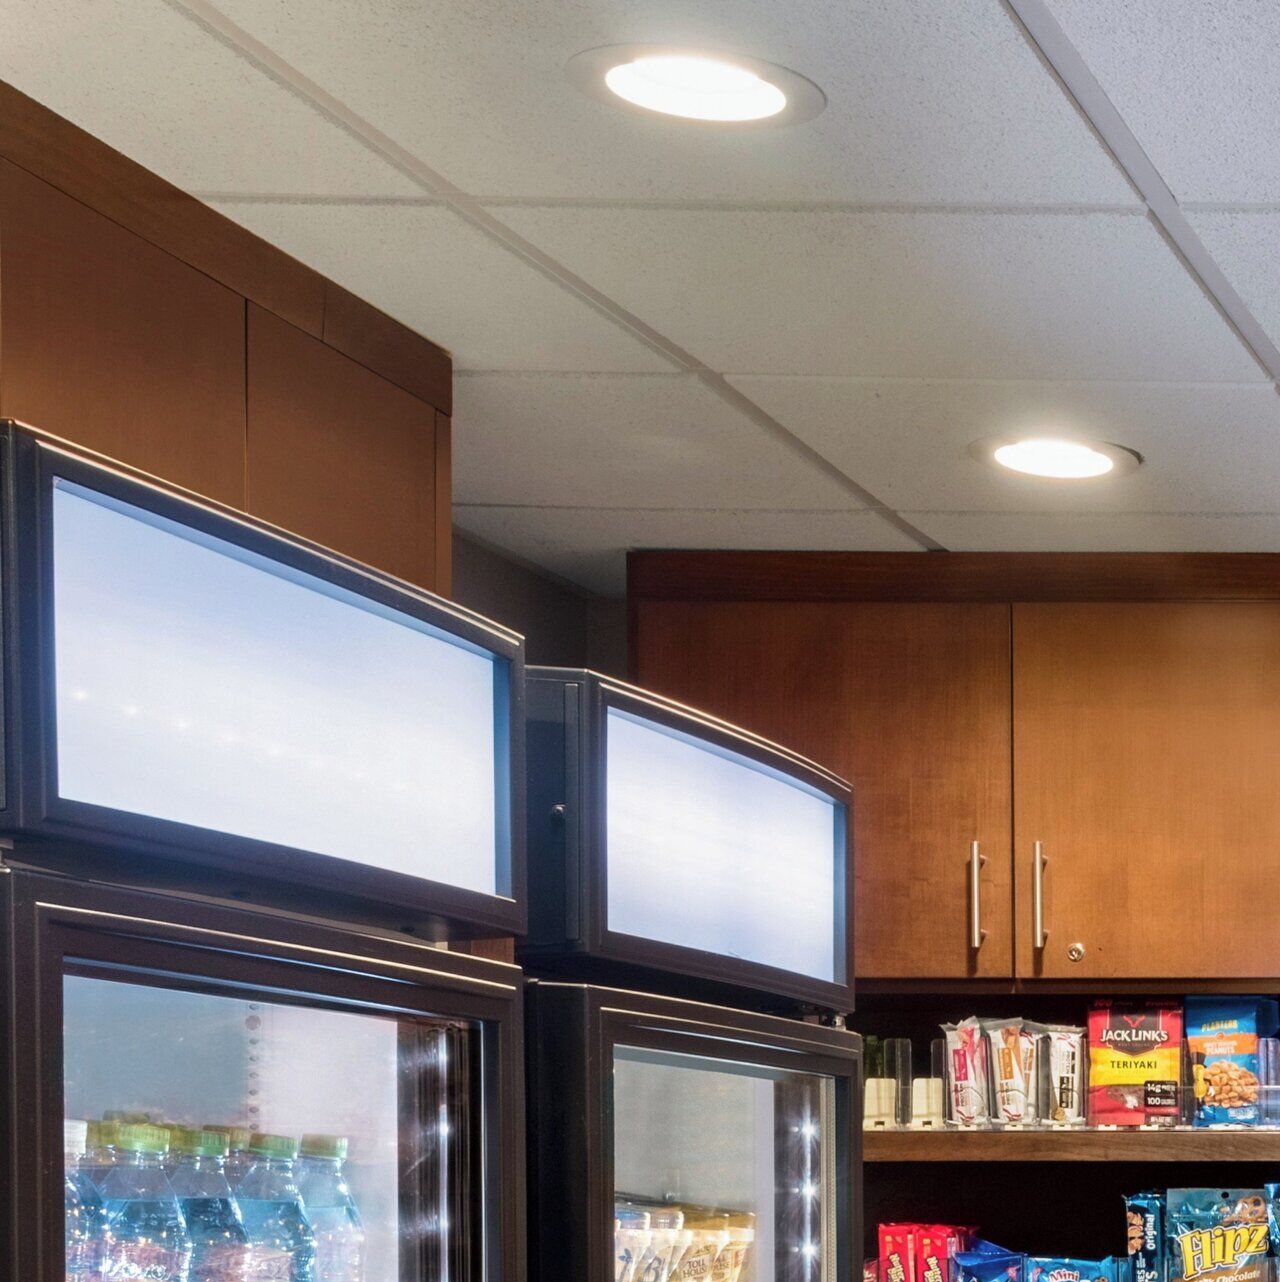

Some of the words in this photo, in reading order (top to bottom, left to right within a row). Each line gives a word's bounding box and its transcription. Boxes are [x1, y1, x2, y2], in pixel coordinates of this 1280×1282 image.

[1202, 1020, 1238, 1032] PLANTERS
[1100, 1029, 1130, 1042] JACK
[1111, 1060, 1157, 1069] TERIYAKI
[1146, 1214, 1157, 1249] original
[1178, 1223, 1269, 1280] Flipz
[688, 1260, 706, 1269] TOLL
[1050, 1270, 1078, 1281] Mini
